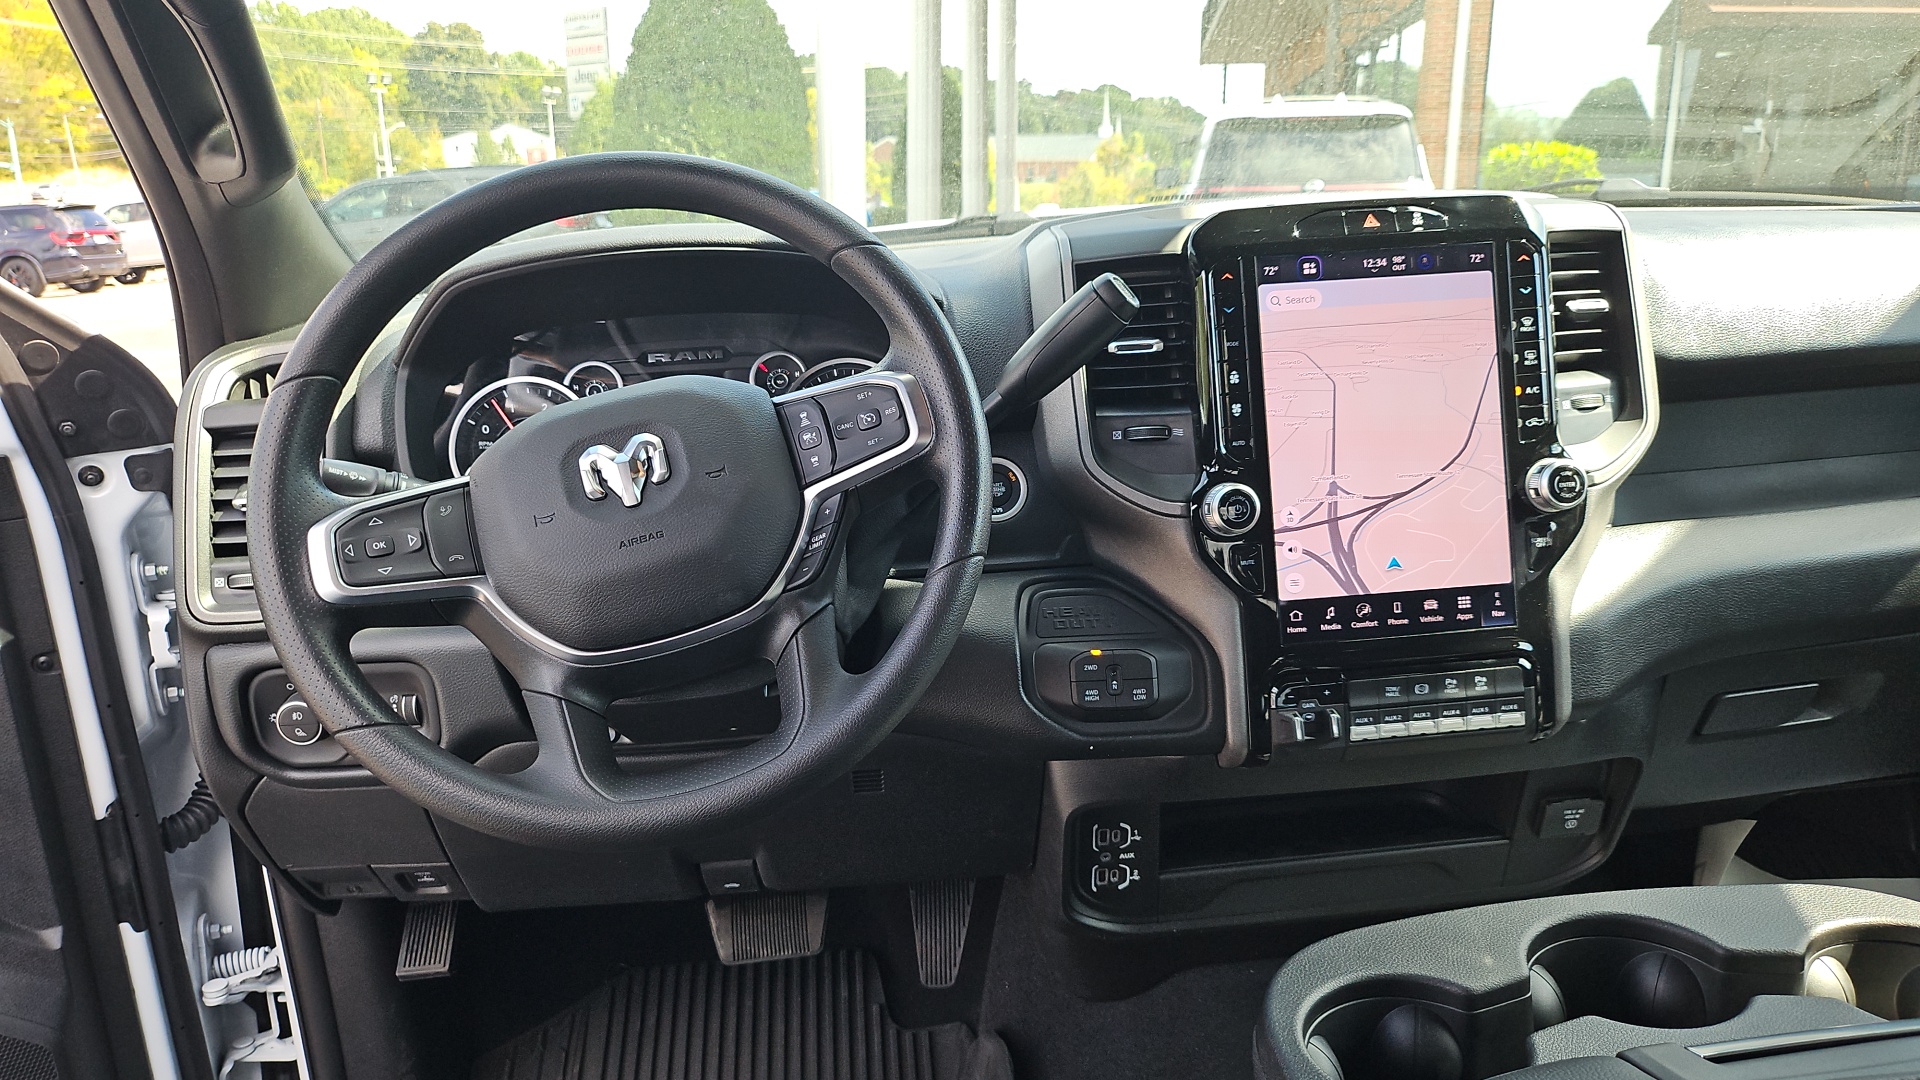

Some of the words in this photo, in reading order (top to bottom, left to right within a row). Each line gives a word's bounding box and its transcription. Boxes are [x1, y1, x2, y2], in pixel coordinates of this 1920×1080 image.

[566, 45, 604, 57] DODGE
[1363, 258, 1388, 269] 12:34
[1391, 262, 1406, 271] OUT
[1285, 294, 1316, 306] Search
[648, 350, 724, 363] RAM
[1525, 386, 1541, 394] A/C
[884, 406, 897, 416] RES
[836, 421, 854, 431] CANC
[328, 467, 344, 476] MIST
[619, 530, 666, 550] AIRBAG
[811, 532, 827, 543] GEAR
[372, 541, 387, 550] OK
[1419, 614, 1445, 623] Vehicle
[1456, 613, 1475, 621] Apps
[1320, 622, 1342, 631] Media
[1351, 620, 1379, 629] Comfort
[1387, 618, 1409, 626] Phone
[1119, 852, 1135, 860] AUX
